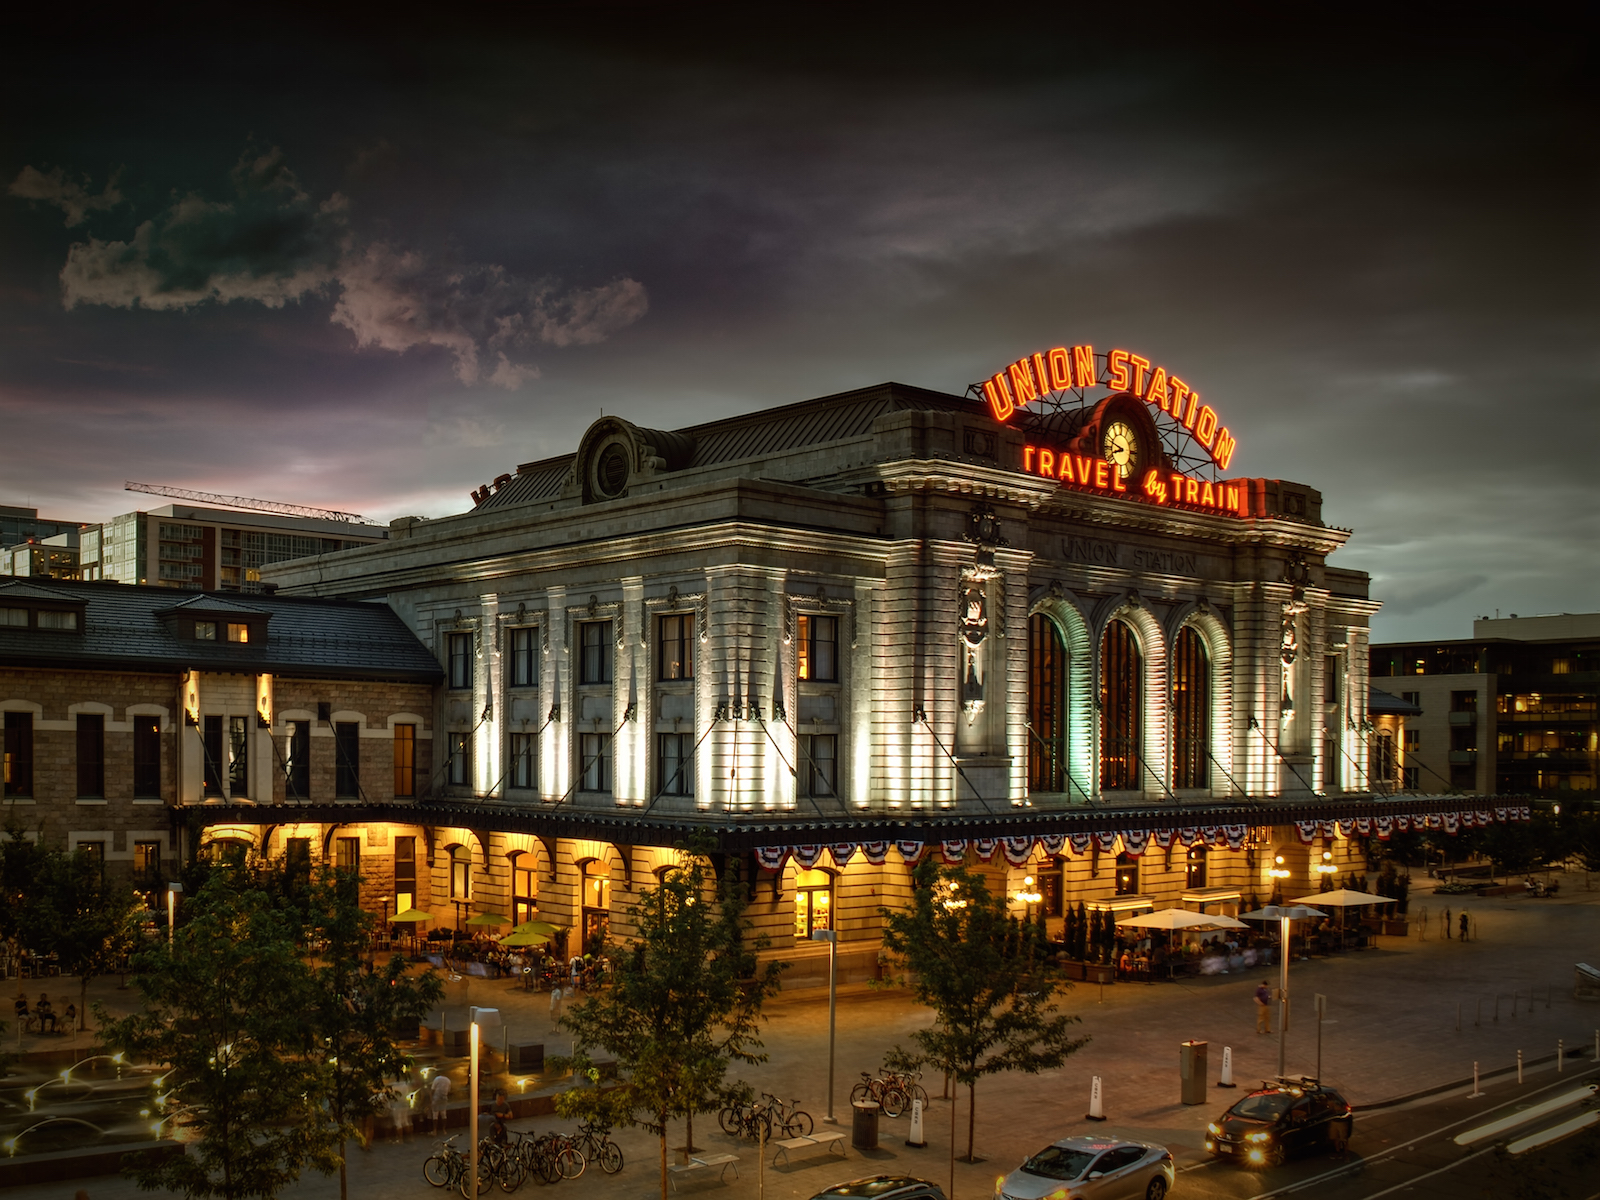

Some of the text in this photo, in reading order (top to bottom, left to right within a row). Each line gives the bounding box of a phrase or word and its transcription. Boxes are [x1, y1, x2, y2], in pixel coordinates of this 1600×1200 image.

[983, 345, 1236, 470] UNION STATION
[1023, 445, 1240, 511] TRAVEL by TRAIN
[1061, 538, 1197, 573] UNION STATION
